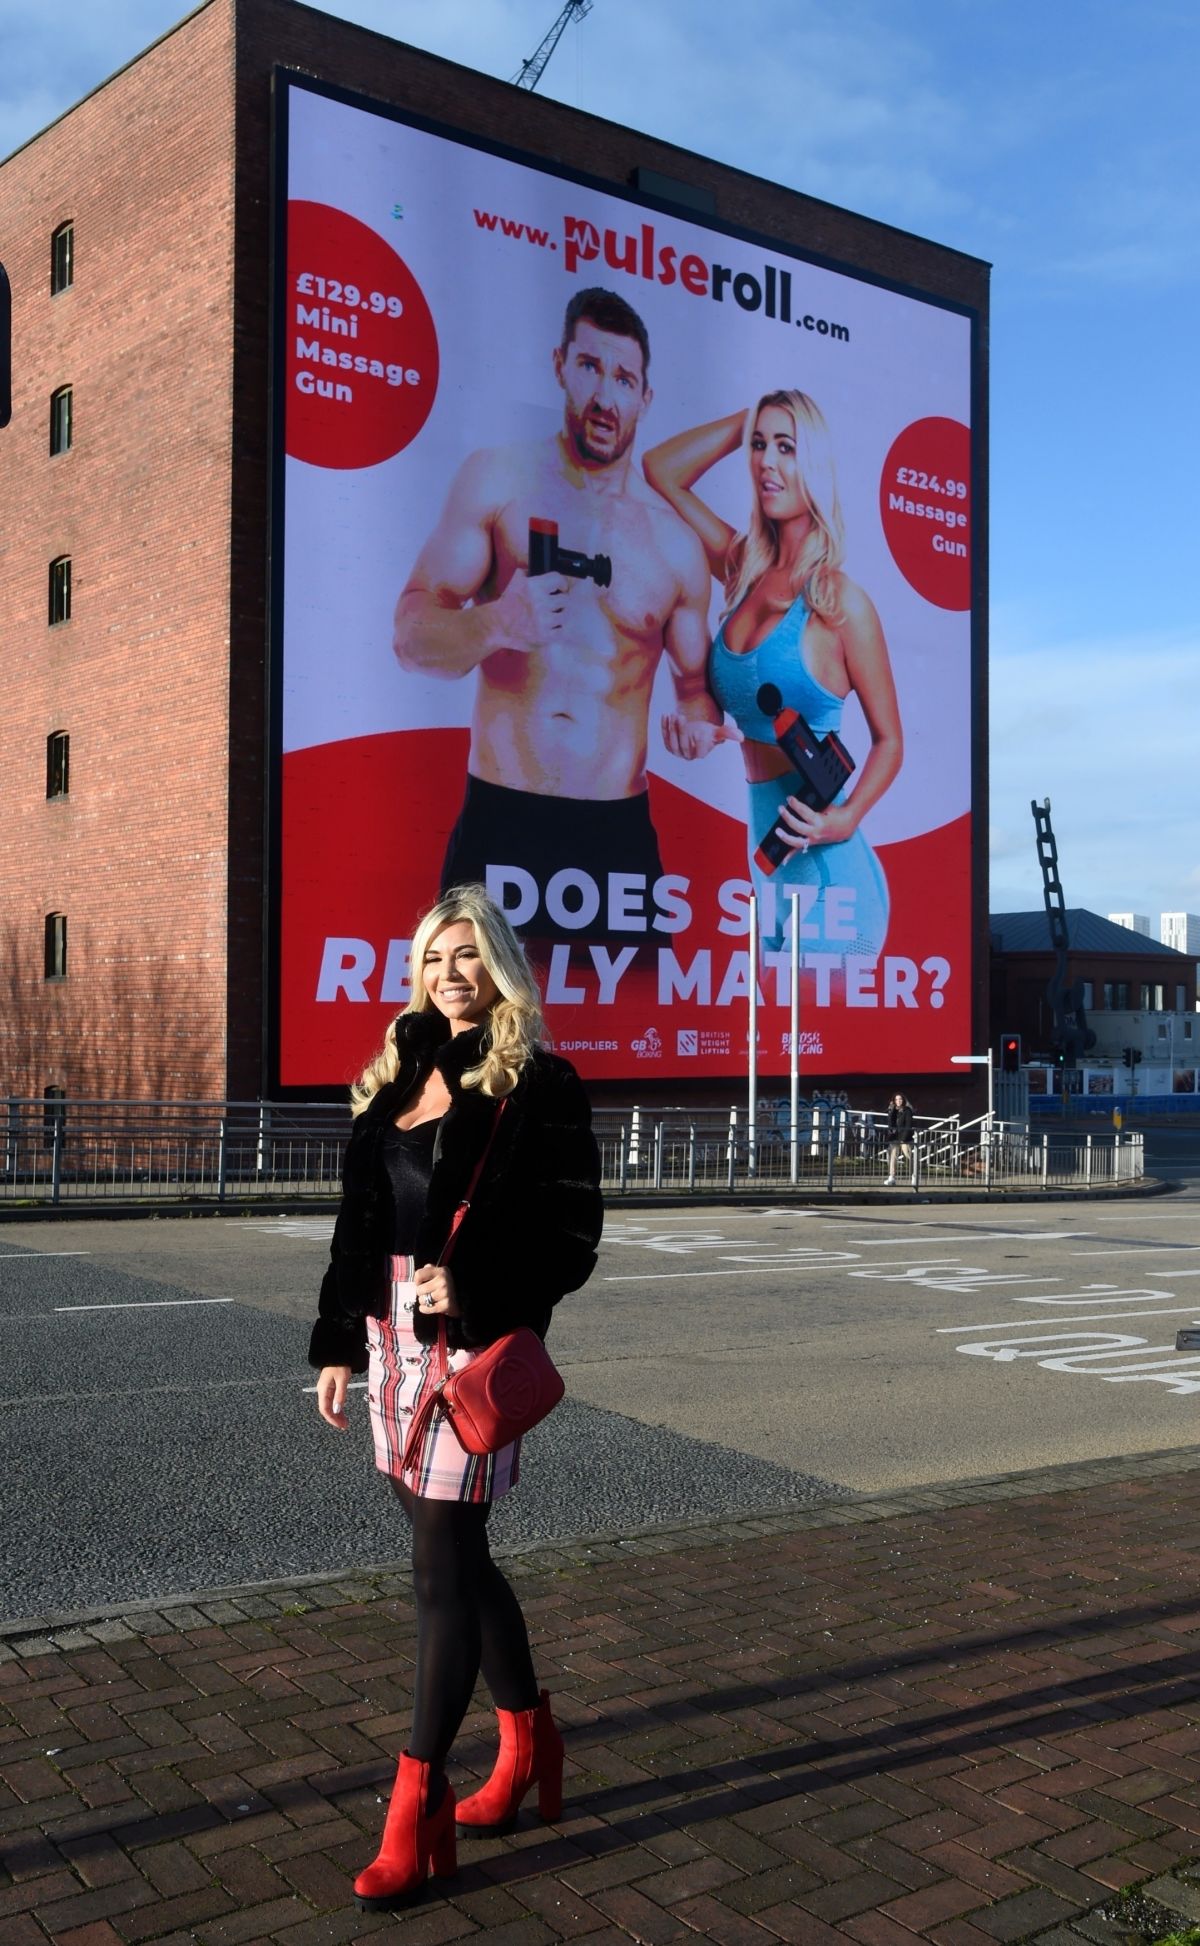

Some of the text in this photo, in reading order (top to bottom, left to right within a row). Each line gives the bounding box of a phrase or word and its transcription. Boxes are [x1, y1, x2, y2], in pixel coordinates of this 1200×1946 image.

[296, 272, 403, 318] £129.99
[296, 304, 358, 338] Mini
[296, 337, 420, 387] Massage
[295, 371, 353, 403] Gun
[896, 467, 967, 499] £224.99
[889, 493, 967, 528] Massage
[932, 534, 967, 558] Gun
[485, 864, 858, 940] DOES SIZE
[315, 937, 951, 1009] RELY MATTER?
[560, 1040, 618, 1051] SUPPLIERS
[630, 1040, 647, 1051] GB
[700, 1031, 730, 1039] BRITISH
